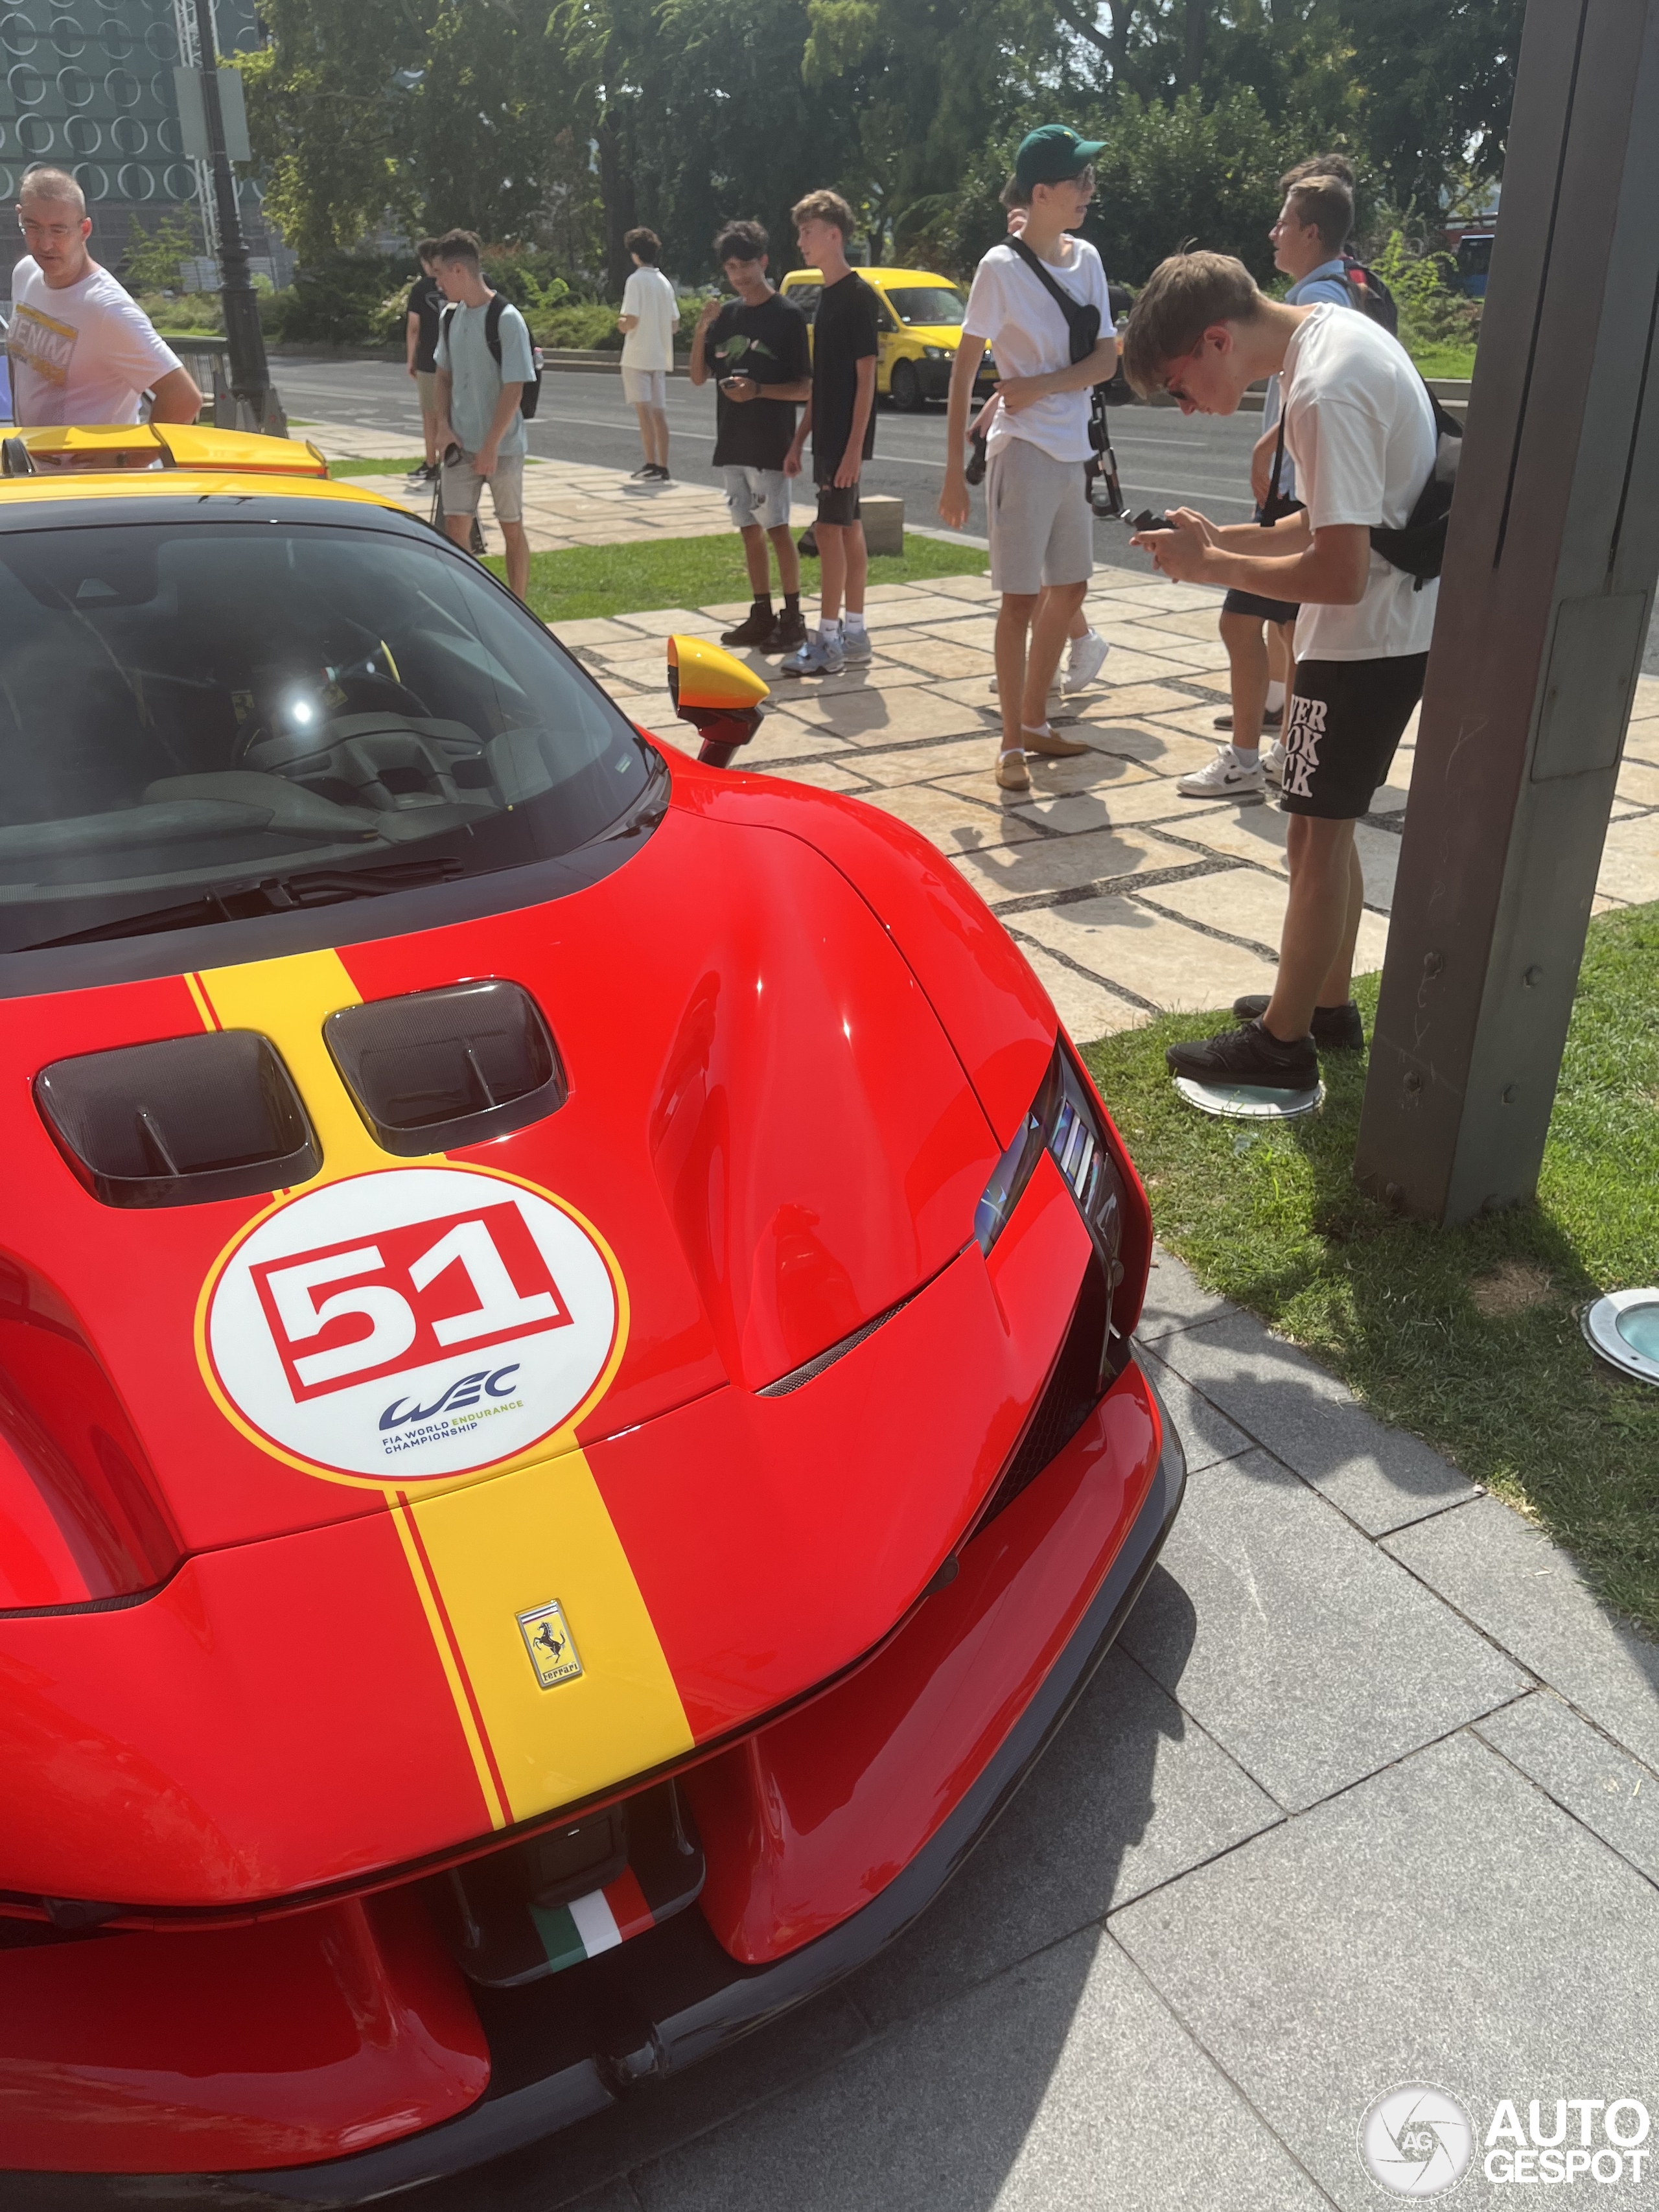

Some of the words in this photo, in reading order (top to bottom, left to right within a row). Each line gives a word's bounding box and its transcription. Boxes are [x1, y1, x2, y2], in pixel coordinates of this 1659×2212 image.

[266, 1219, 559, 1387] 51
[378, 1363, 520, 1431] WEC
[382, 1435, 402, 1447] FIA
[404, 1421, 450, 1439] WORLD
[451, 1400, 524, 1426] ENDURANCE
[385, 1422, 478, 1454] CHAMPIONSHIP
[542, 1662, 578, 1682] Ferrari
